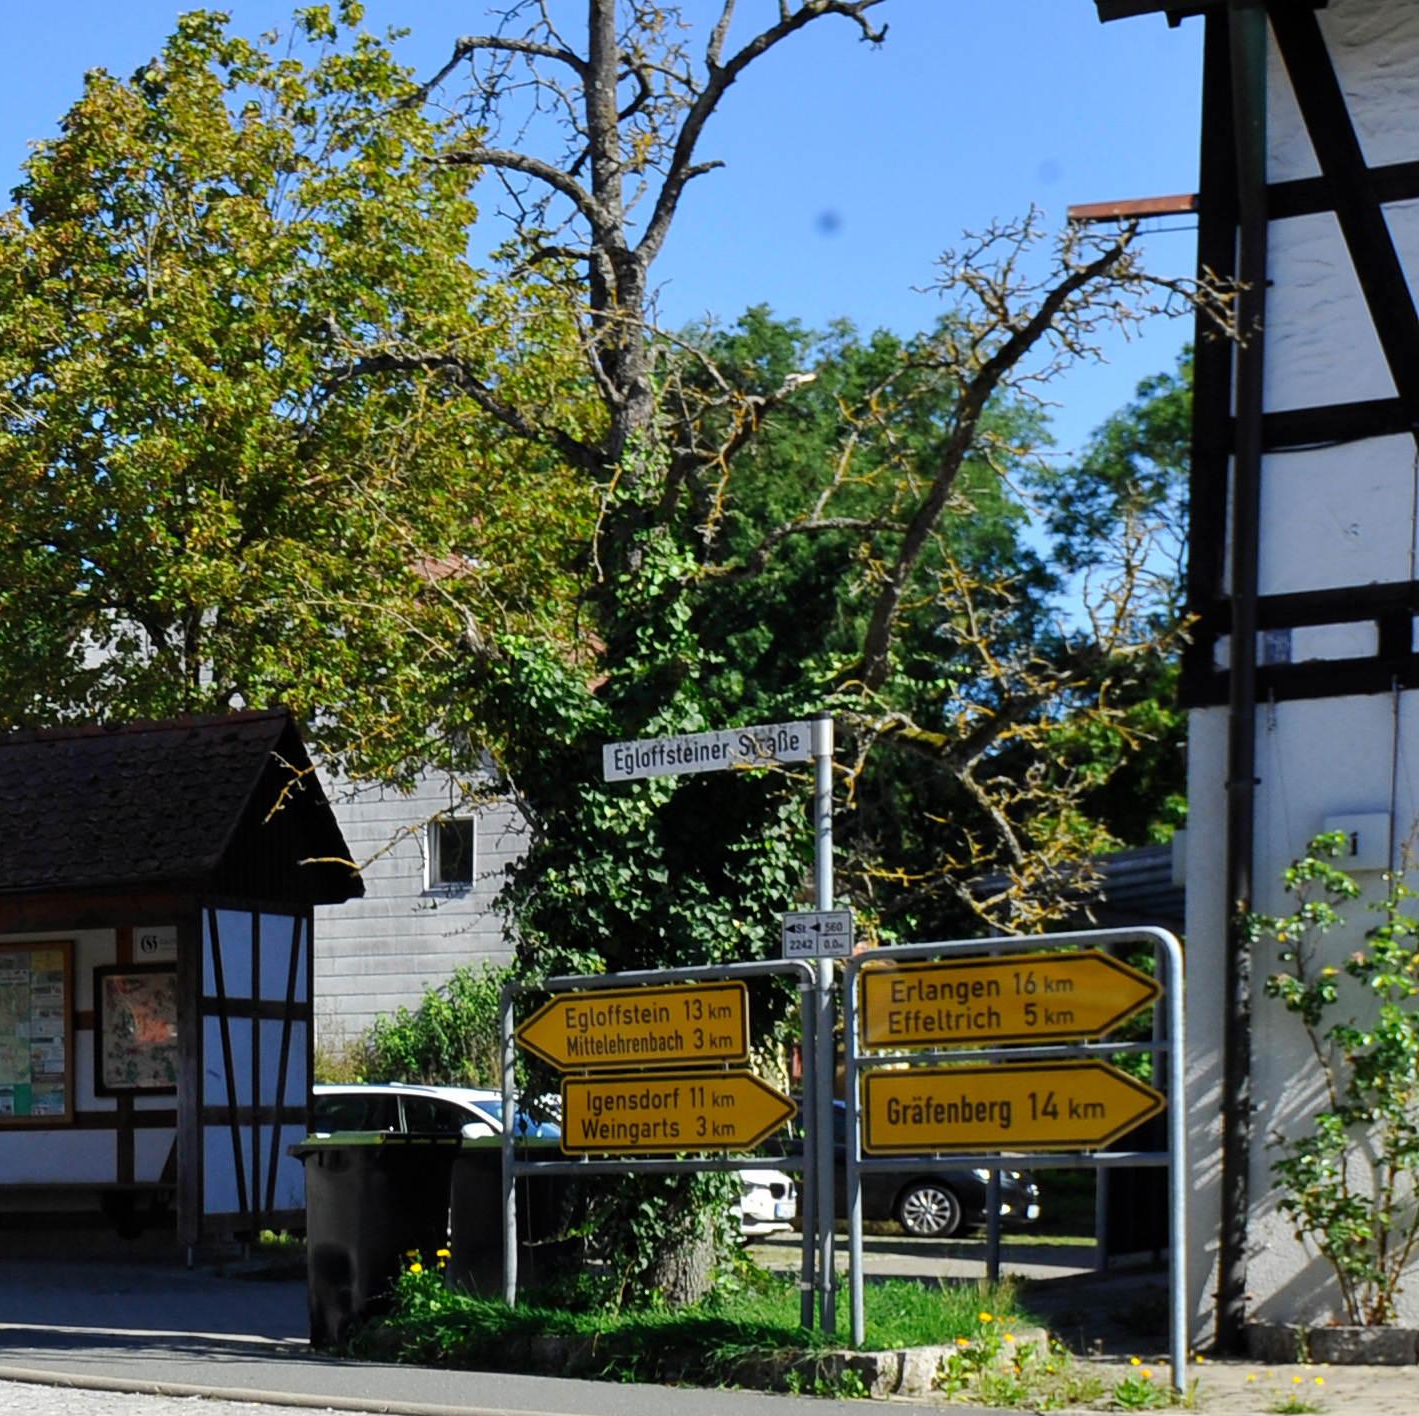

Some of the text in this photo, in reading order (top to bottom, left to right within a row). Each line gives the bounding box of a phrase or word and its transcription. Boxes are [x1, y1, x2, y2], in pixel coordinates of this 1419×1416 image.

[614, 730, 800, 775] Egloffsteiner Straße
[789, 940, 813, 951] 2242
[891, 971, 1074, 1005] Erlangen 16 km
[565, 999, 732, 1033] Egloffstein 13 km
[888, 1003, 1074, 1034] Effeltrich 5 km
[566, 1028, 733, 1057] Mittelehrenbach 3 km
[586, 1086, 735, 1117] Igensdorf 11 km
[886, 1091, 1106, 1130] Gräfenberg 14 km
[581, 1115, 735, 1144] Weingarts 3 km
